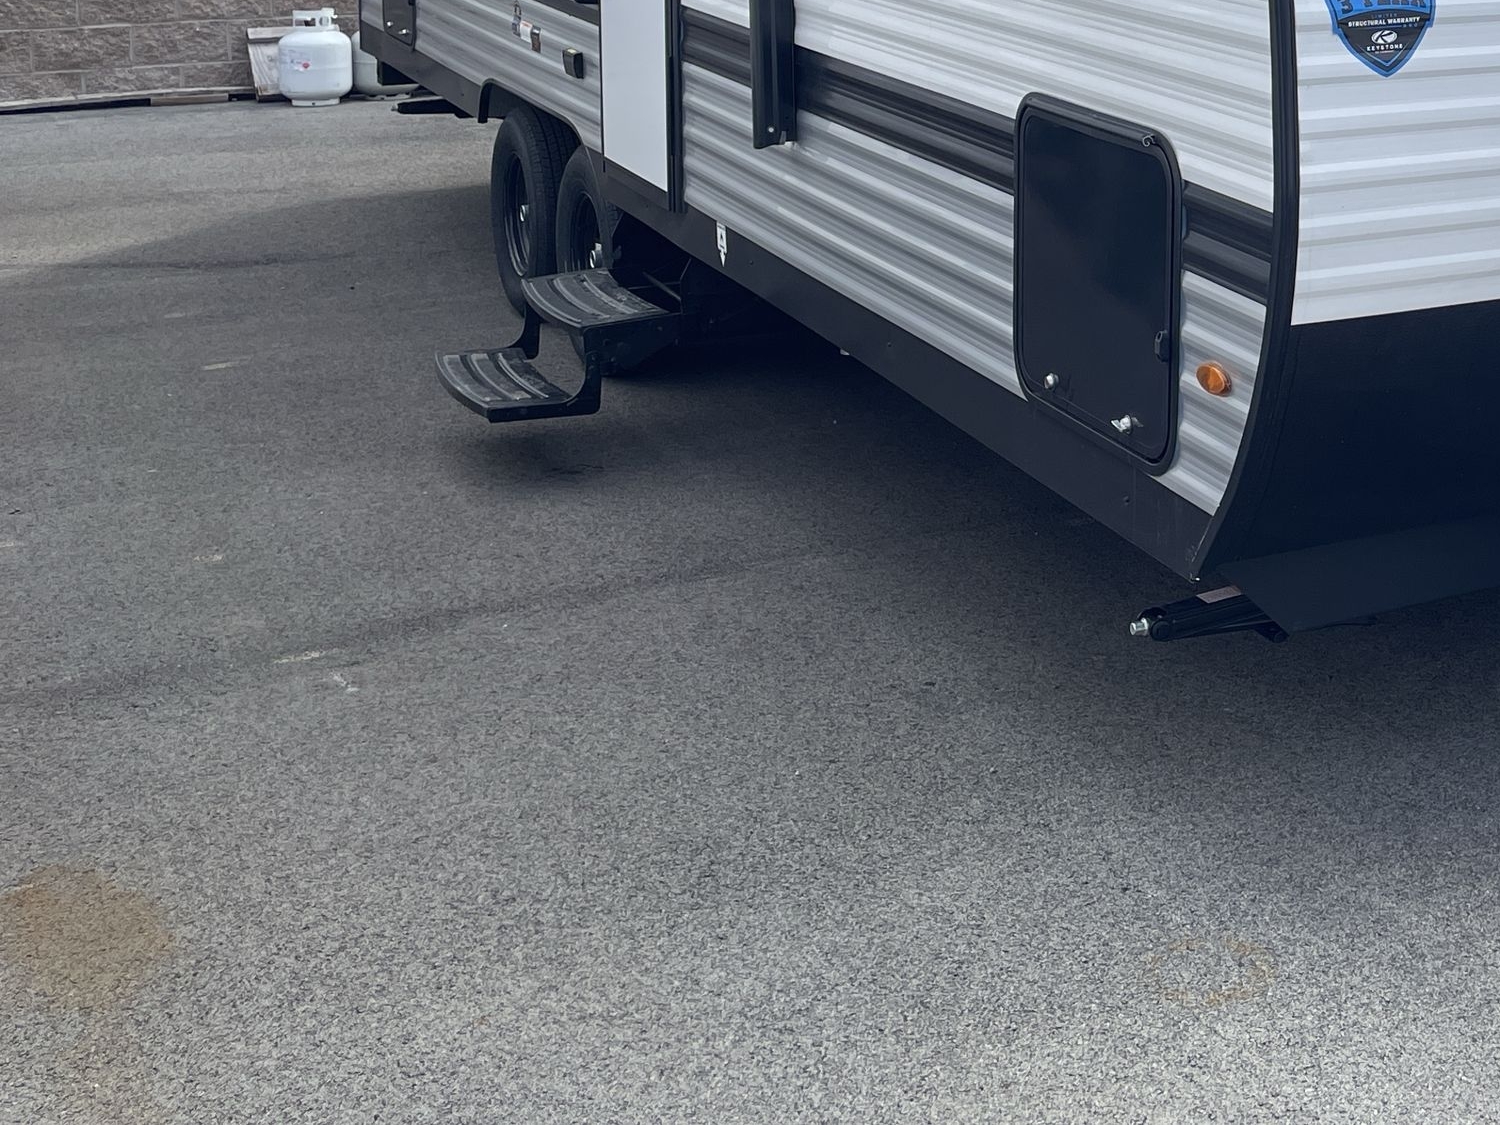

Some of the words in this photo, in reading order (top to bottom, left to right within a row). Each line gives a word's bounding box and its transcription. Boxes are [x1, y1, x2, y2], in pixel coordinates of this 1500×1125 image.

[1348, 19, 1386, 28] STRUCTURAL
[1387, 16, 1421, 25] WARRANTY
[1366, 43, 1403, 51] KEYSTONE
